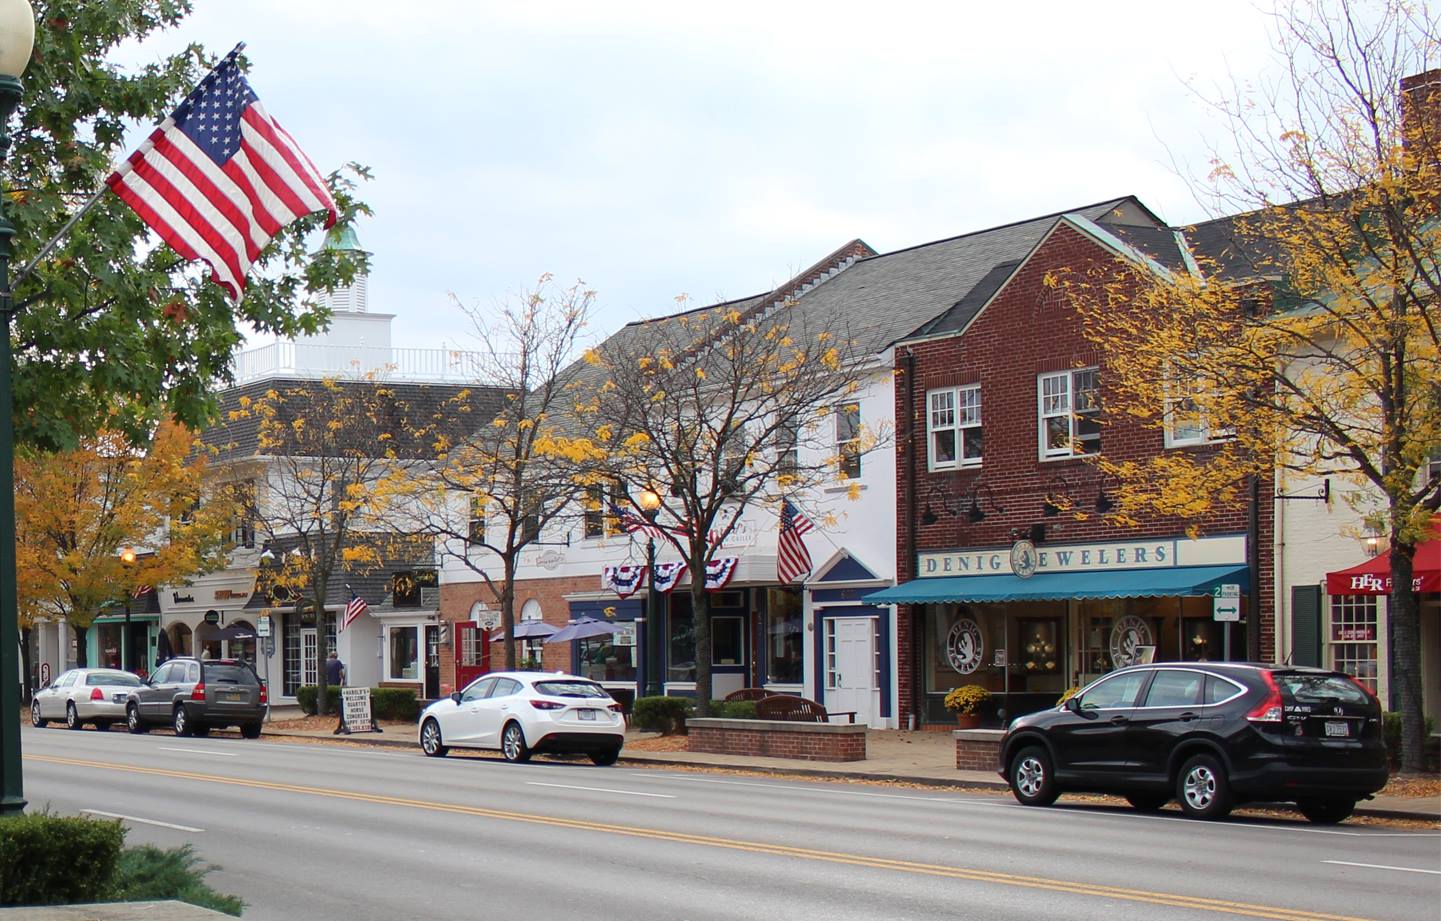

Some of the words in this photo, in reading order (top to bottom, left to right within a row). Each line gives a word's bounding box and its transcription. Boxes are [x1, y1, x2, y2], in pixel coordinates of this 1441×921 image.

[926, 555, 1001, 573] DENIG
[1350, 573, 1383, 591] HER
[1214, 586, 1221, 597] 2
